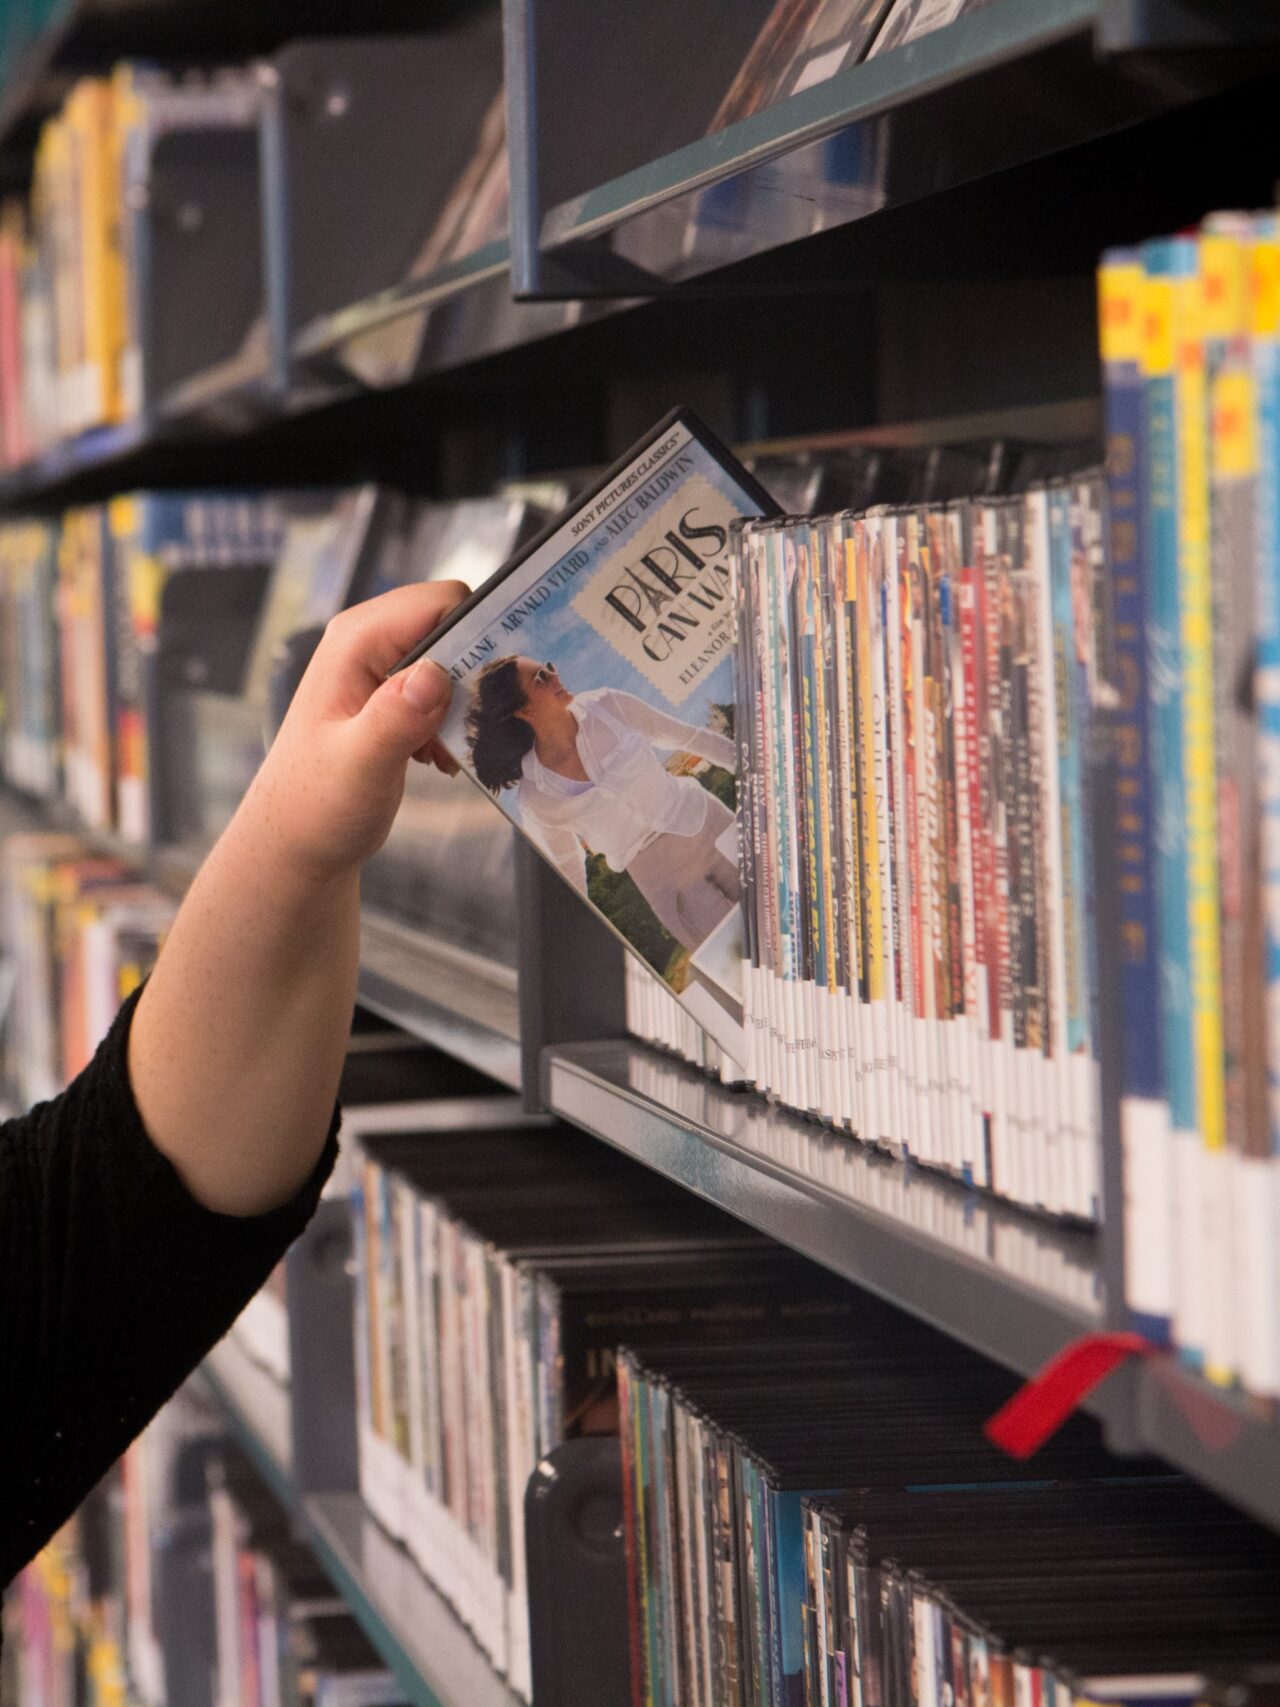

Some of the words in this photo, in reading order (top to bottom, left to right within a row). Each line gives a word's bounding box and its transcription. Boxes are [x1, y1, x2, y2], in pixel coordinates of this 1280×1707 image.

[570, 509, 596, 537] SONY
[594, 471, 639, 515] PICTURES
[461, 634, 497, 672] LANE
[500, 584, 552, 636] ARNAUD
[547, 548, 590, 590] VIARD
[604, 502, 639, 539] ALEC
[635, 452, 696, 513] BALDWIN
[604, 506, 729, 634] PARIS
[640, 597, 699, 663] CAN
[678, 631, 731, 685] ELEANOR
[811, 907, 821, 953] BY
